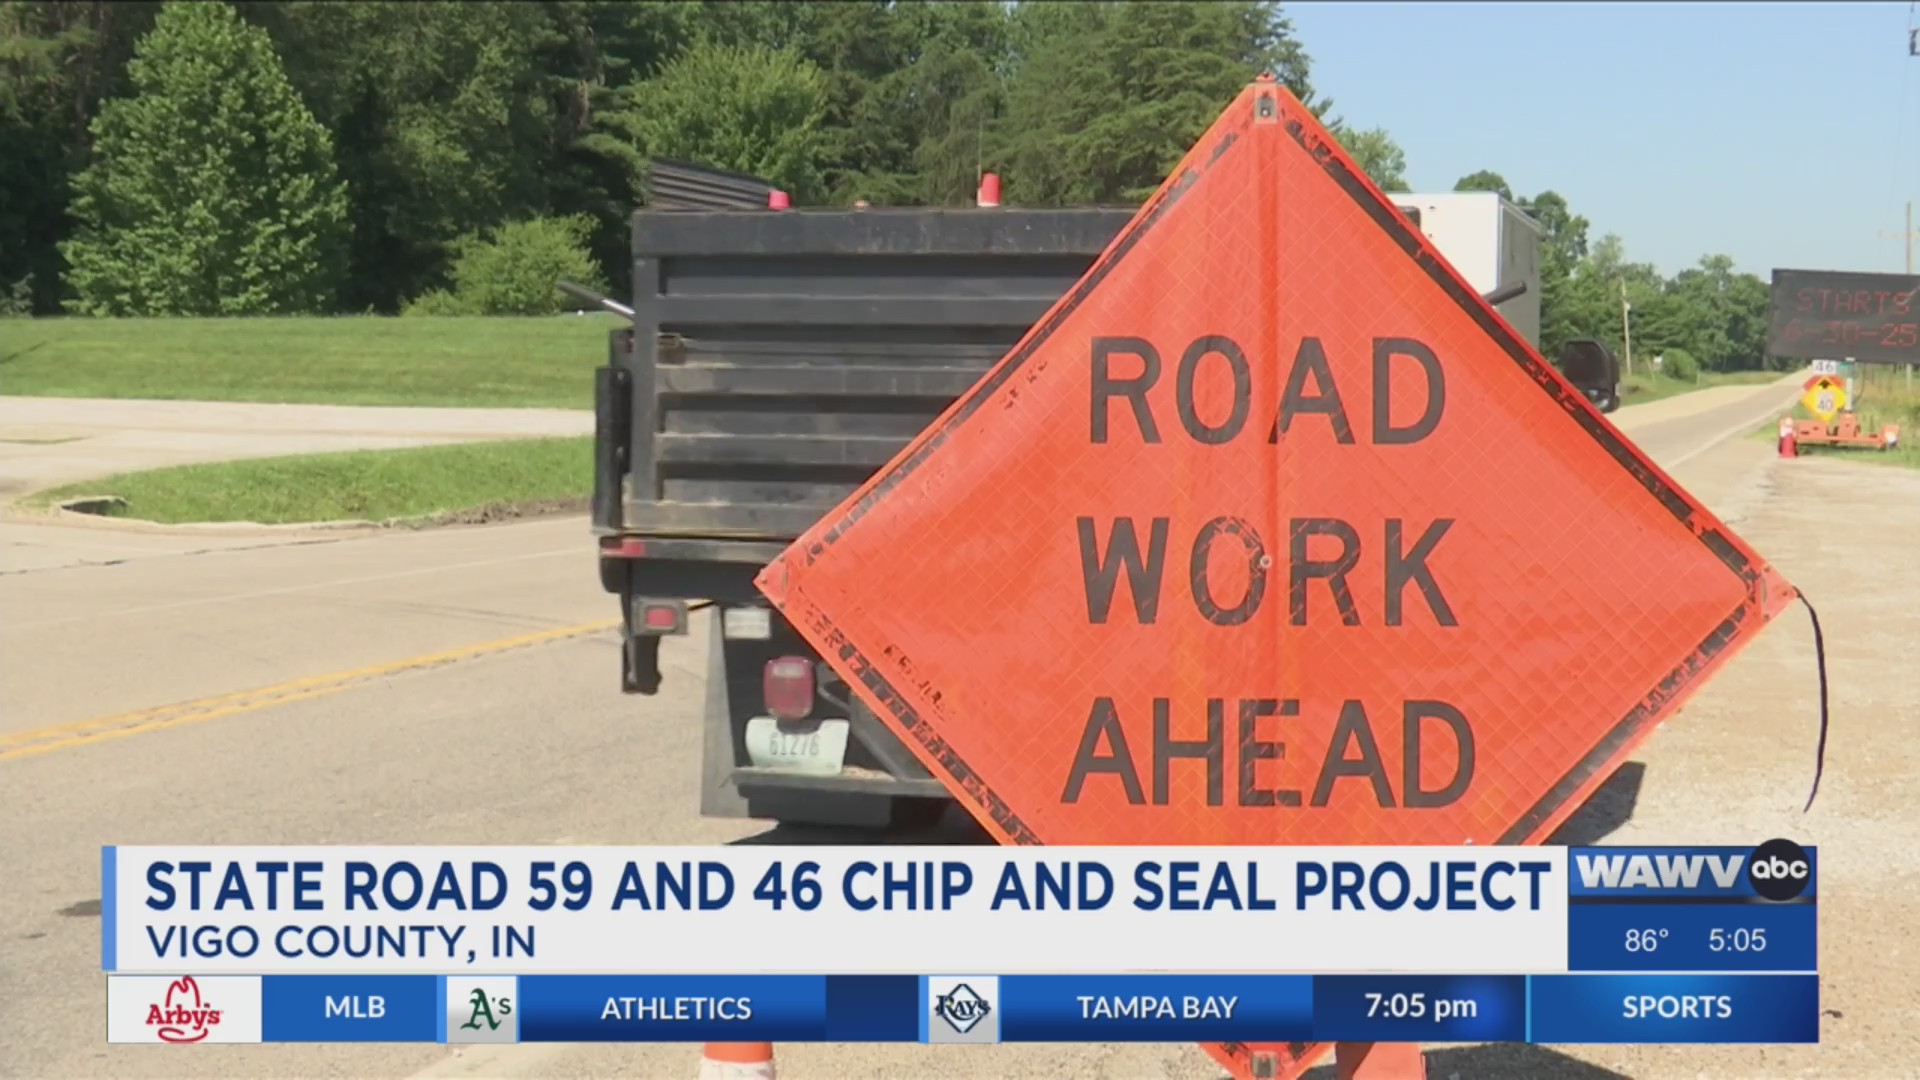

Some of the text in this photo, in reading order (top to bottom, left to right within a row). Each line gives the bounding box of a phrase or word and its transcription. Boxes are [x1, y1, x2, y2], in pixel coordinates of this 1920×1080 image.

[1796, 287, 1911, 315] STARTS
[1089, 335, 1446, 445] ROAD
[1815, 361, 1834, 372] 46
[1076, 516, 1459, 627] WORK
[1060, 697, 1476, 809] AHEAD
